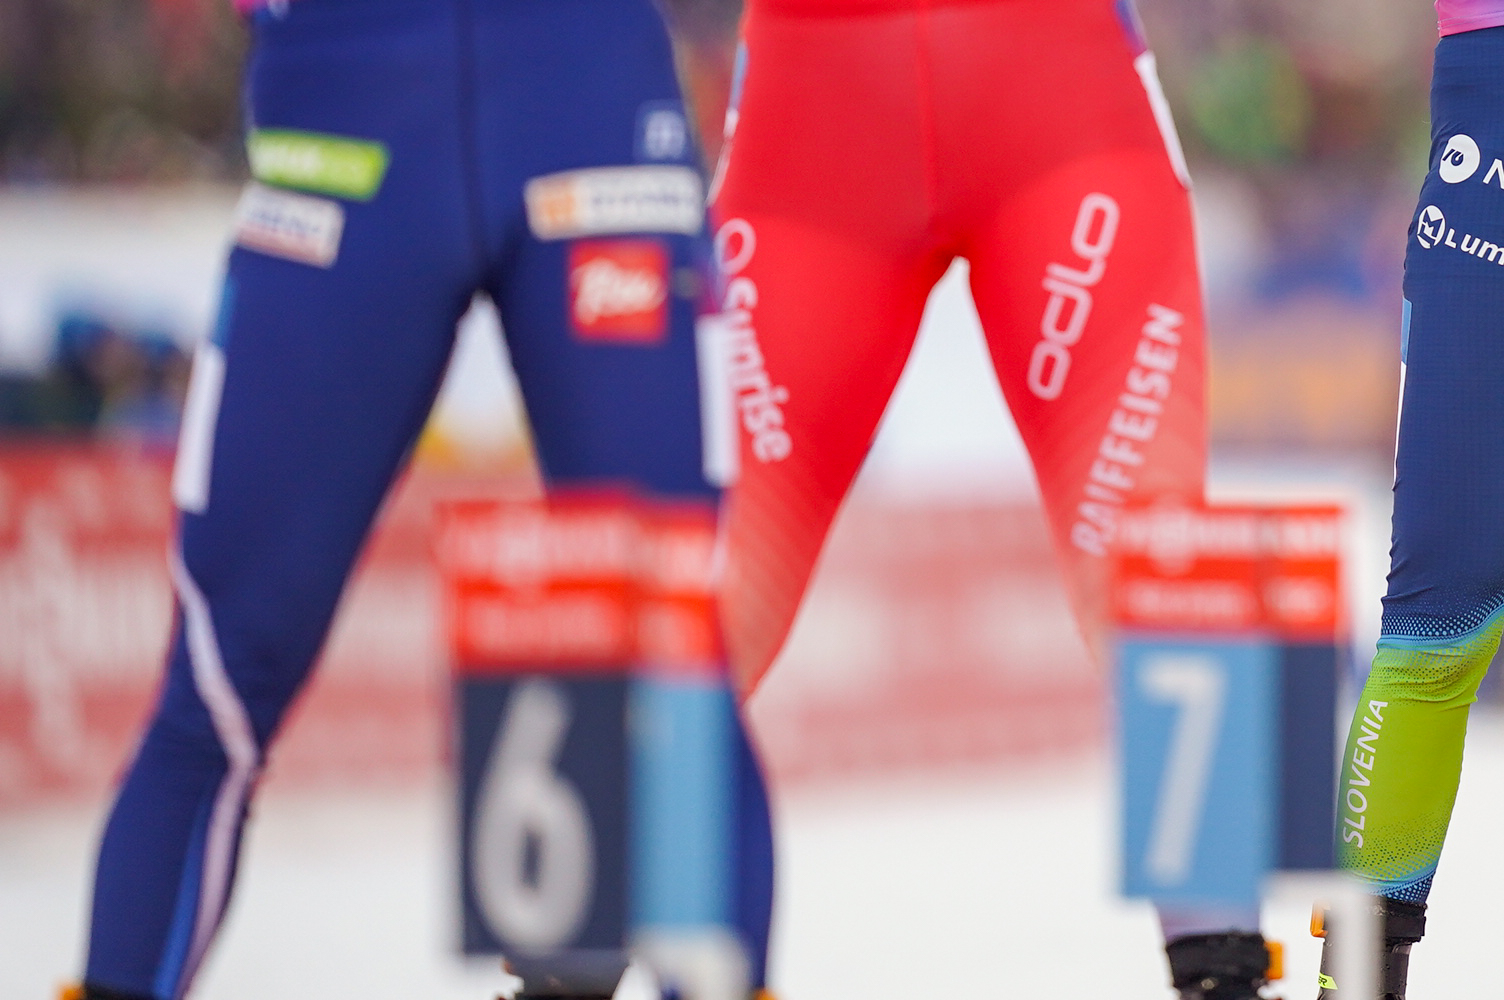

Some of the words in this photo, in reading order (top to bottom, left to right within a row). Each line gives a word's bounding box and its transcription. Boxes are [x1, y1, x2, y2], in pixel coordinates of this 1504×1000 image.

[1026, 191, 1121, 401] odlo
[468, 672, 596, 960] 6
[1136, 650, 1228, 888] 7
[1342, 700, 1389, 848] SLOVENIA
